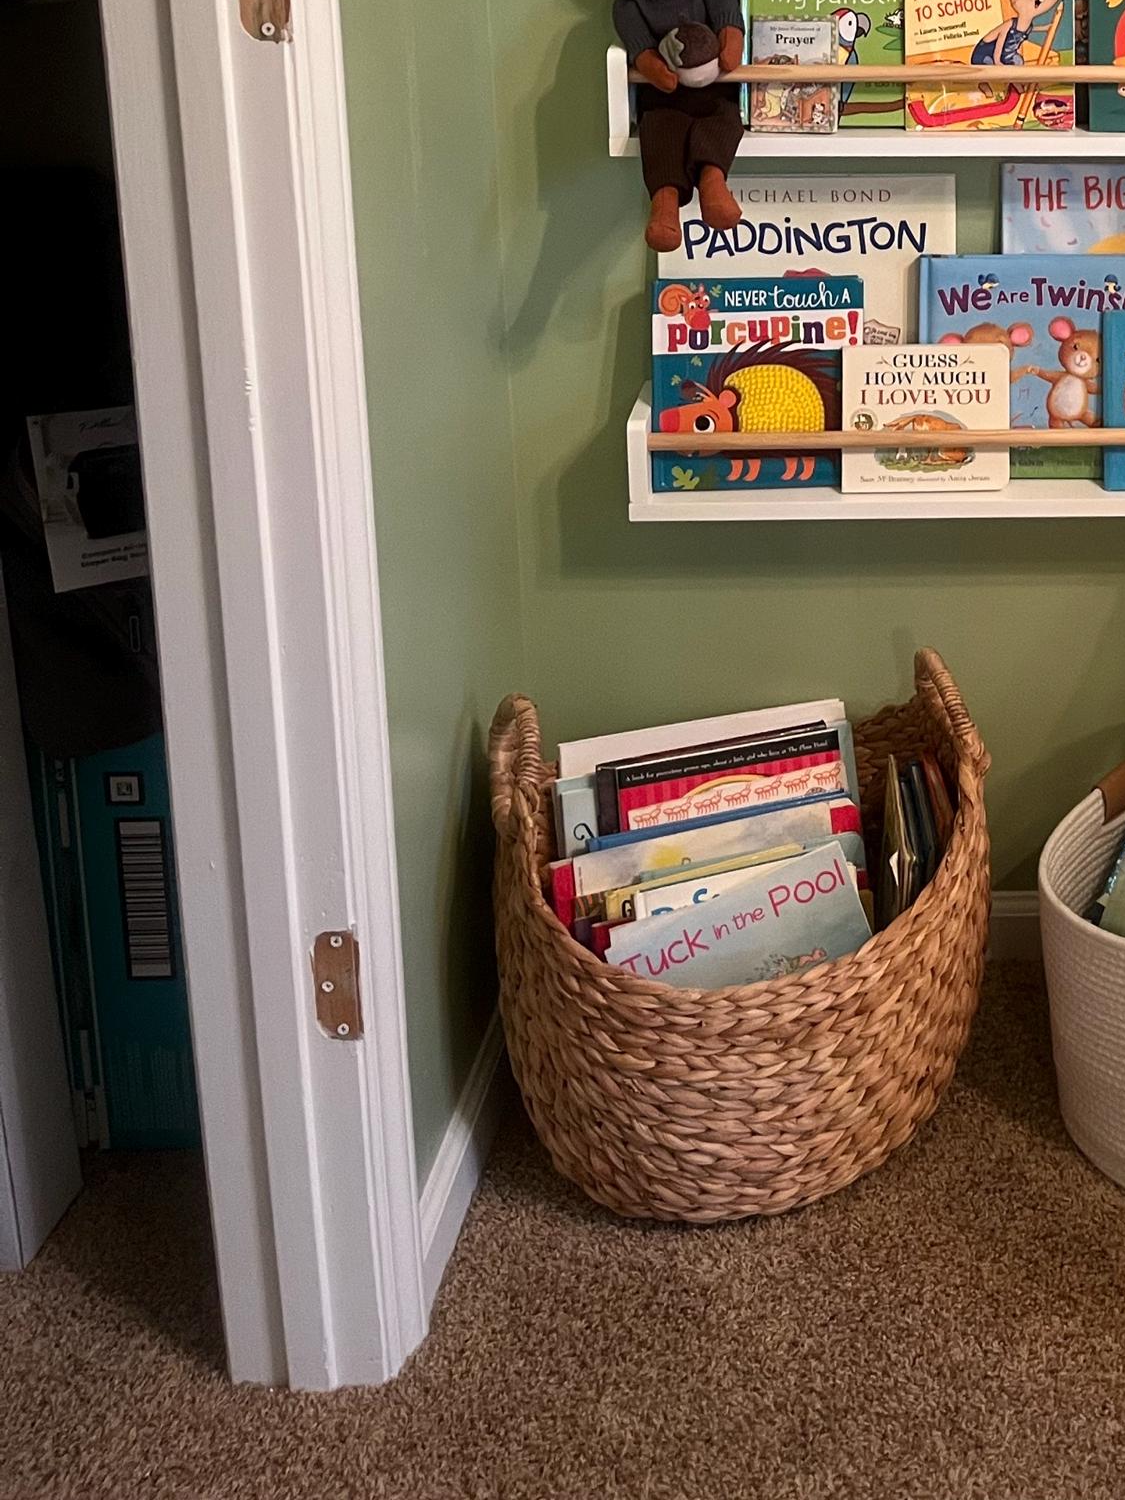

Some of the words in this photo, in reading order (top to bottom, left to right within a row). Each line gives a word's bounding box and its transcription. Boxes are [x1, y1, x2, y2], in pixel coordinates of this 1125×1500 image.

[915, 5, 932, 22] TO
[775, 32, 816, 47] Prayer
[963, 29, 980, 38] Bond
[830, 189, 892, 203] BOND
[1017, 178, 1070, 211] THE
[682, 217, 927, 260] PADDINGTON
[724, 290, 767, 307] NEVER
[767, 281, 841, 309] touch
[841, 290, 850, 304] A
[937, 283, 993, 316] We
[997, 289, 1030, 305] Are
[667, 310, 860, 353] porcupine!
[892, 353, 958, 368] GUESS
[864, 371, 915, 386] HOW
[922, 371, 986, 386] MUCH
[860, 389, 867, 405] I
[877, 388, 937, 405] LOVE
[943, 388, 992, 405] YOU
[619, 927, 710, 977] Tuck
[732, 906, 766, 932] the
[768, 858, 846, 918] Pool
